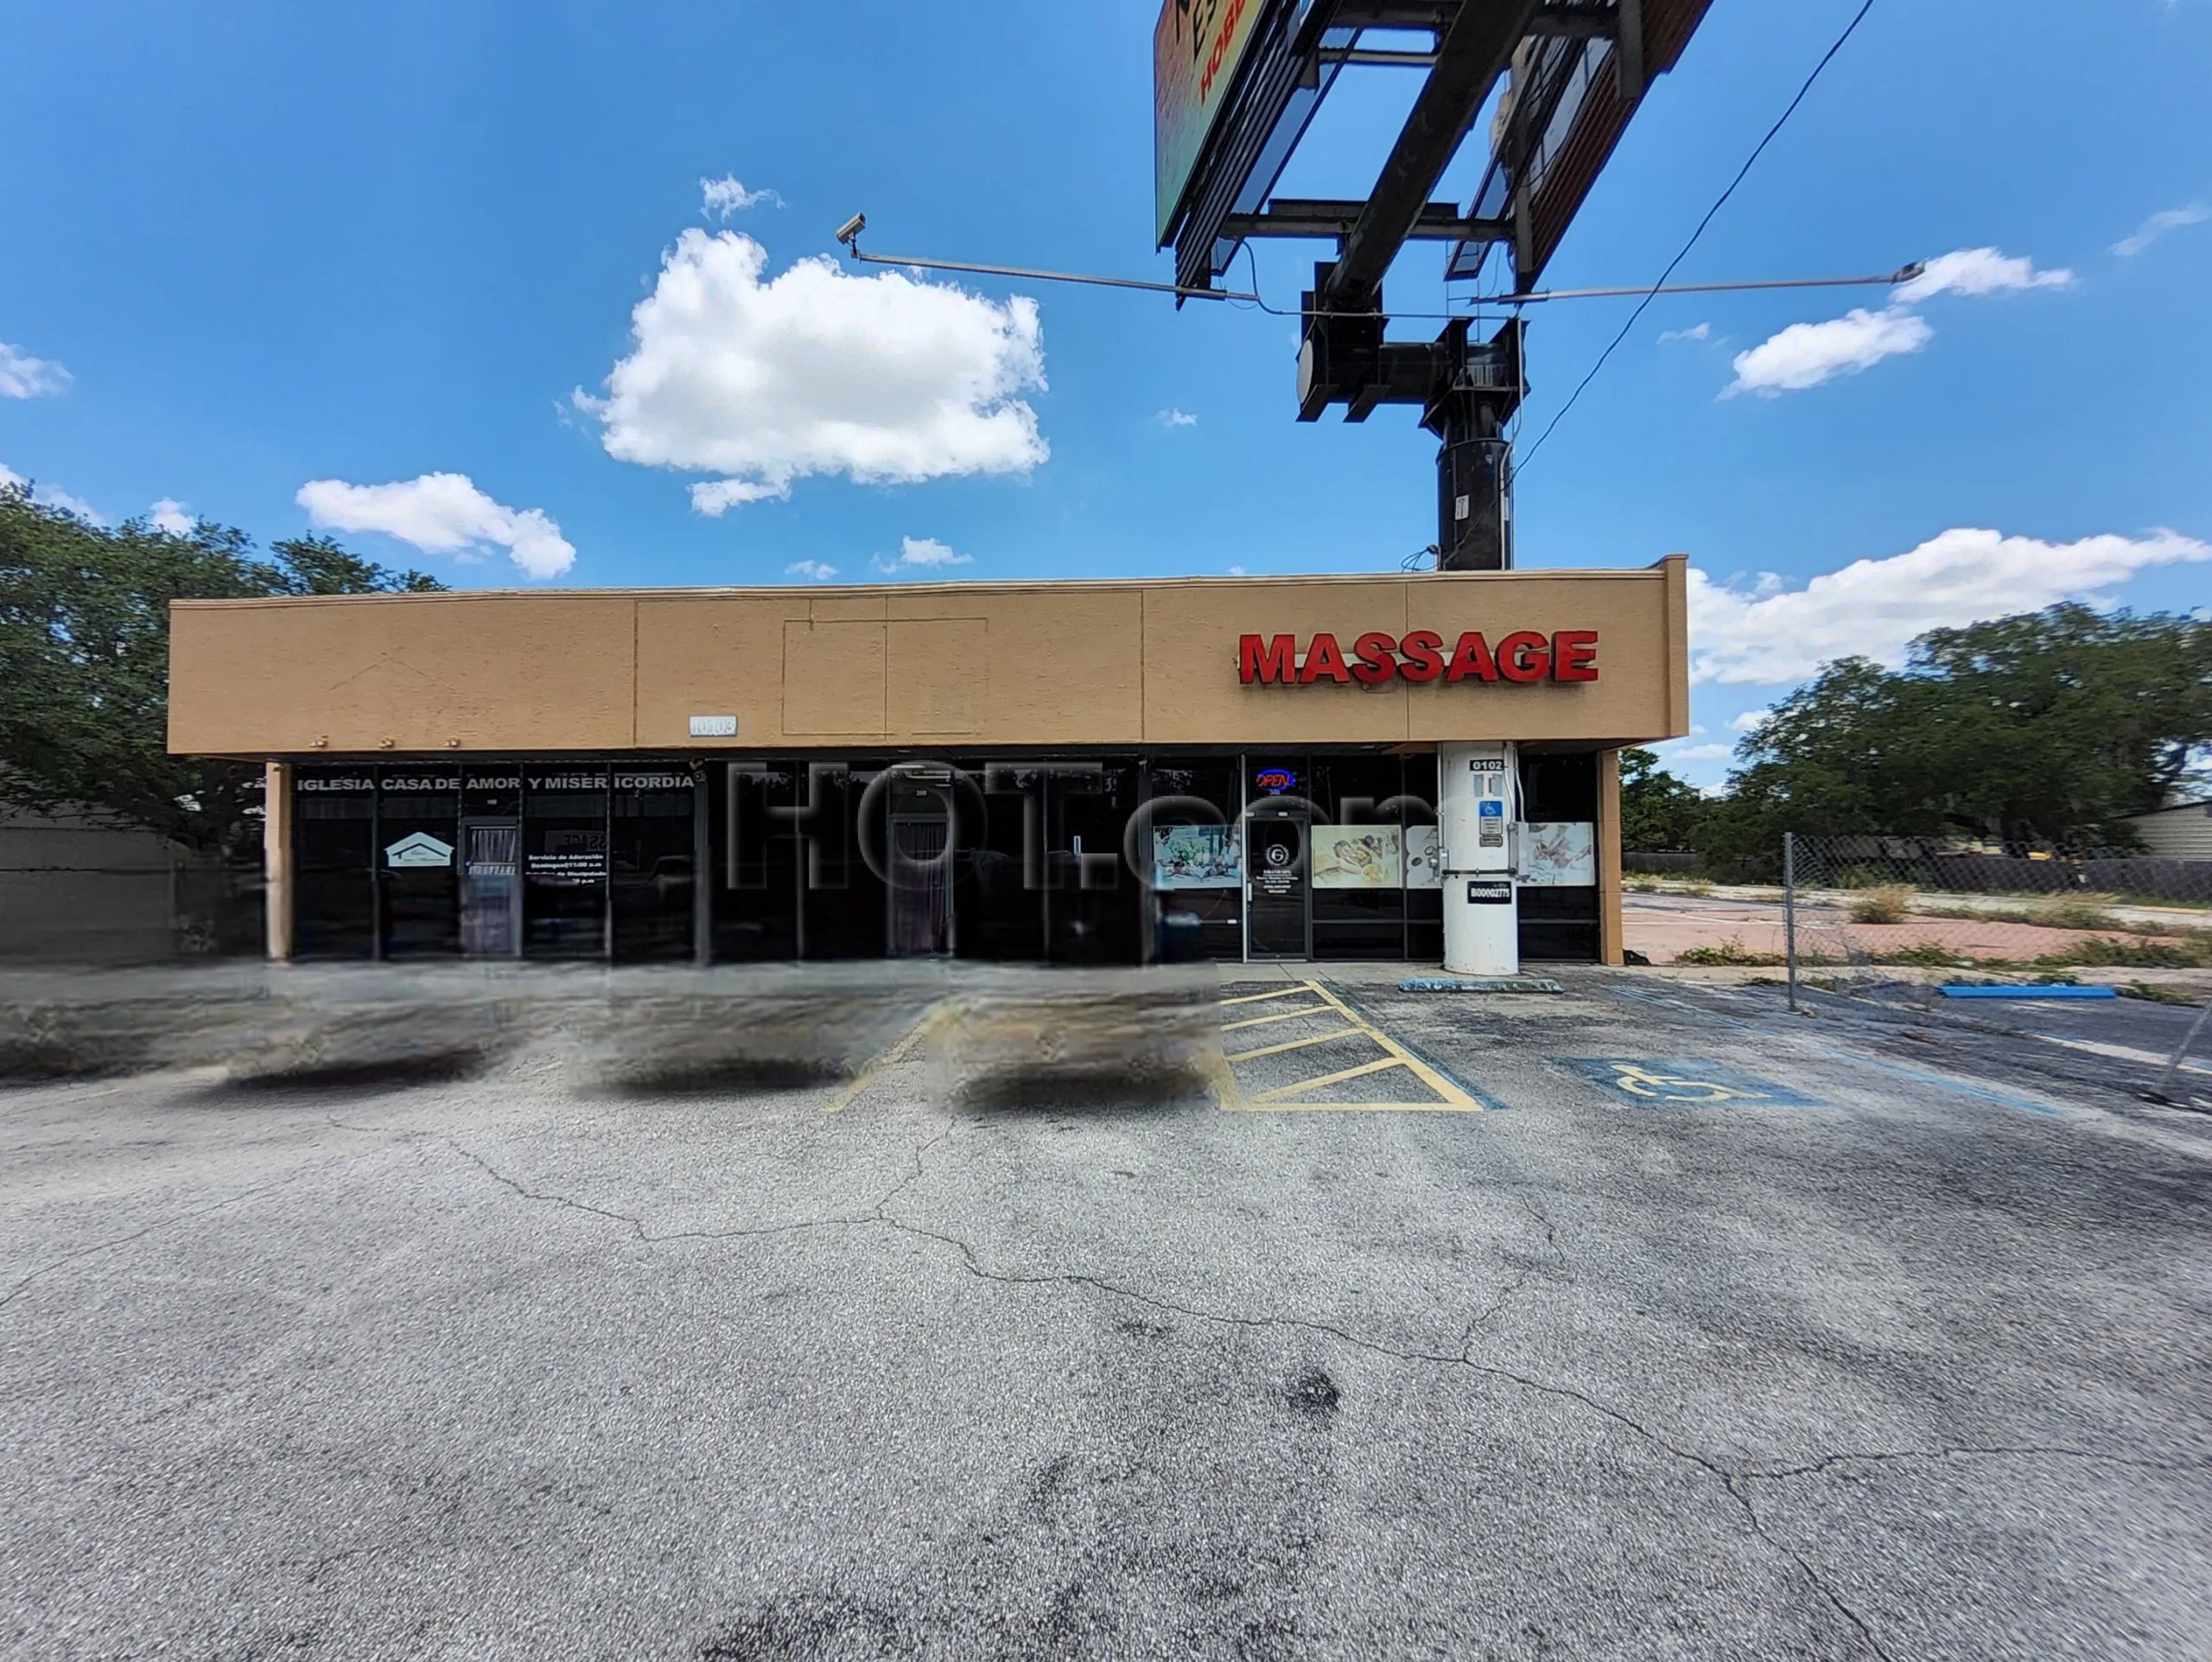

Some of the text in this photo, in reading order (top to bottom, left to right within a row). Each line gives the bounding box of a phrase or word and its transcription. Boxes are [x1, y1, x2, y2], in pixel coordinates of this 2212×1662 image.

[1238, 630, 1599, 685] MASSAGE
[1472, 761, 1503, 770] 0102
[297, 779, 375, 791] IGLESIA
[381, 778, 432, 791] CASA
[435, 778, 460, 790] DE
[466, 777, 520, 790] AMOR
[528, 778, 540, 790] Y
[1255, 774, 1290, 788] OPEN
